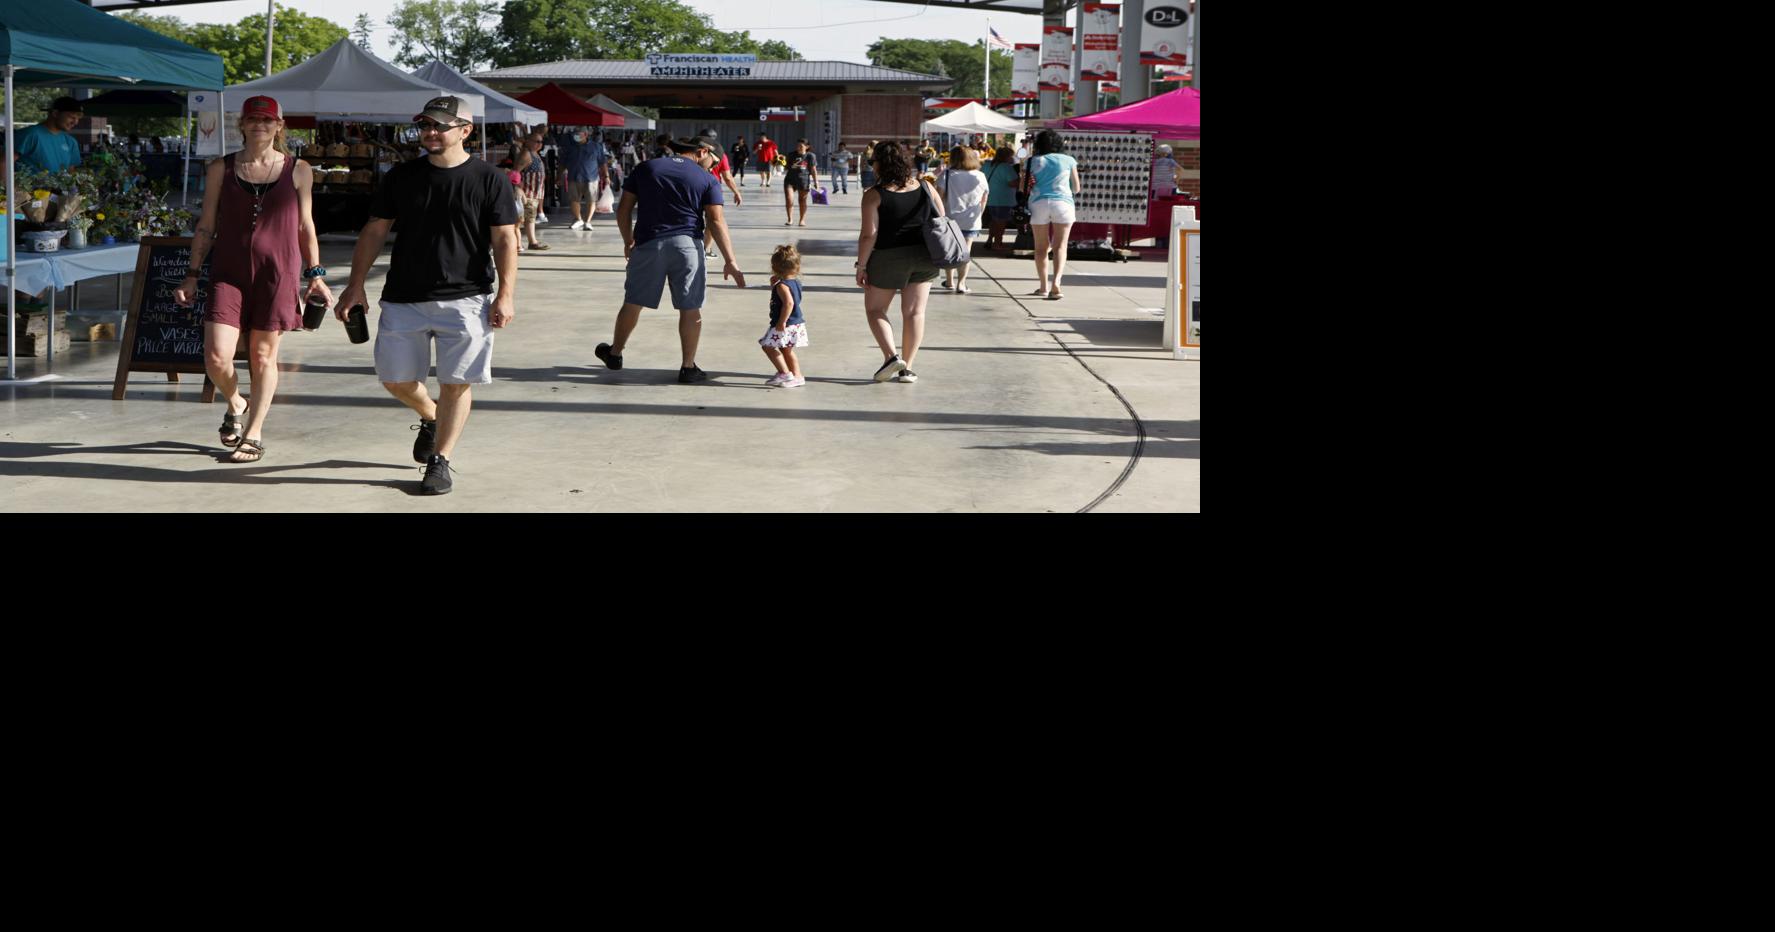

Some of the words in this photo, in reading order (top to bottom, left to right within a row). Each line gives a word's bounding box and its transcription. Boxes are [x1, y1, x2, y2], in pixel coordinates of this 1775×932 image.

[663, 54, 718, 63] Franciscan
[653, 67, 747, 76] AMPHITHEATER
[160, 327, 200, 340] VASES
[137, 337, 169, 355] PRICE
